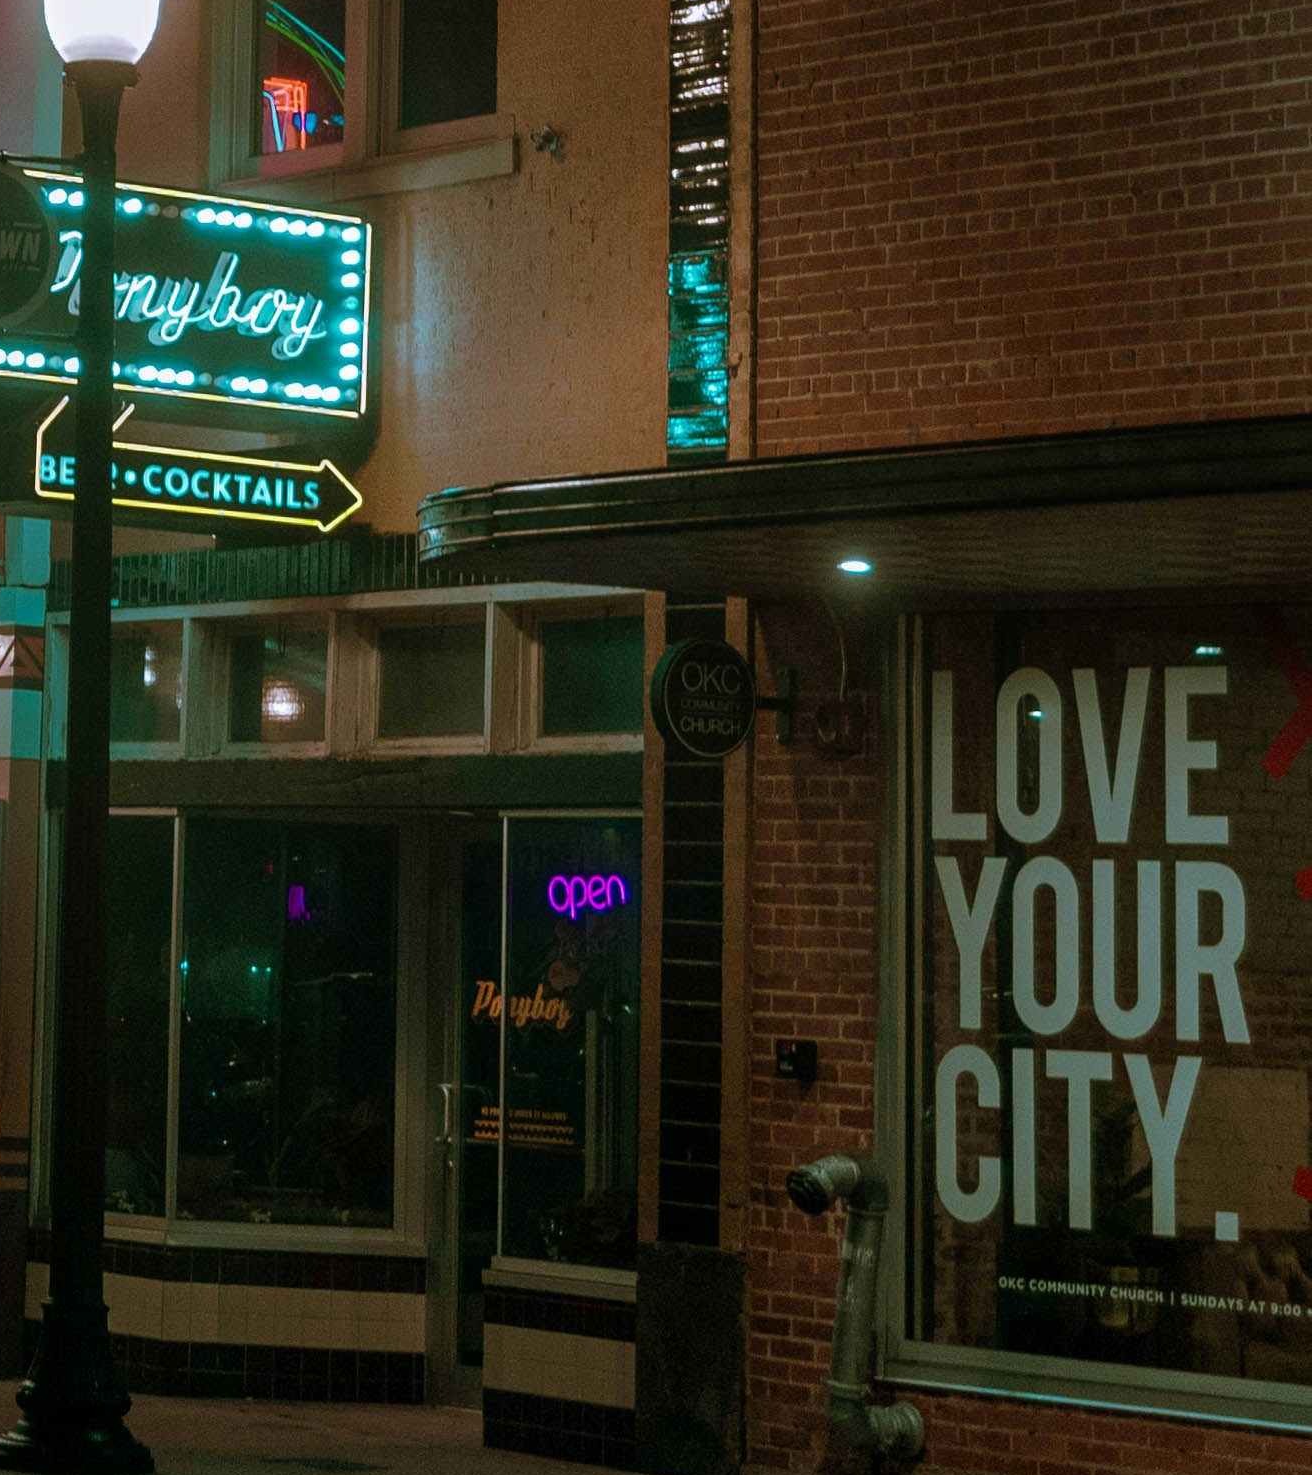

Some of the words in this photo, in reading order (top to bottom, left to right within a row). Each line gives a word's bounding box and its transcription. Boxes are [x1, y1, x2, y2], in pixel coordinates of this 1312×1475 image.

[142, 464, 321, 510] COCKTAILS
[681, 660, 741, 696] OKC
[680, 697, 744, 714] COMMUNITY
[680, 714, 741, 737] CHURCH
[931, 665, 1230, 846] LOVE
[547, 873, 628, 921] open
[933, 855, 1252, 1045] YOUR
[472, 978, 575, 1030] Ponyboy
[934, 1044, 1241, 1243] CITY.
[998, 1275, 1028, 1291] OKC
[1029, 1277, 1107, 1299] COMMUNITY
[1110, 1286, 1164, 1304] CHURCH
[1180, 1292, 1245, 1313] SUNDAYS
[1247, 1300, 1267, 1313] AT
[1270, 1303, 1302, 1318] 9:00
